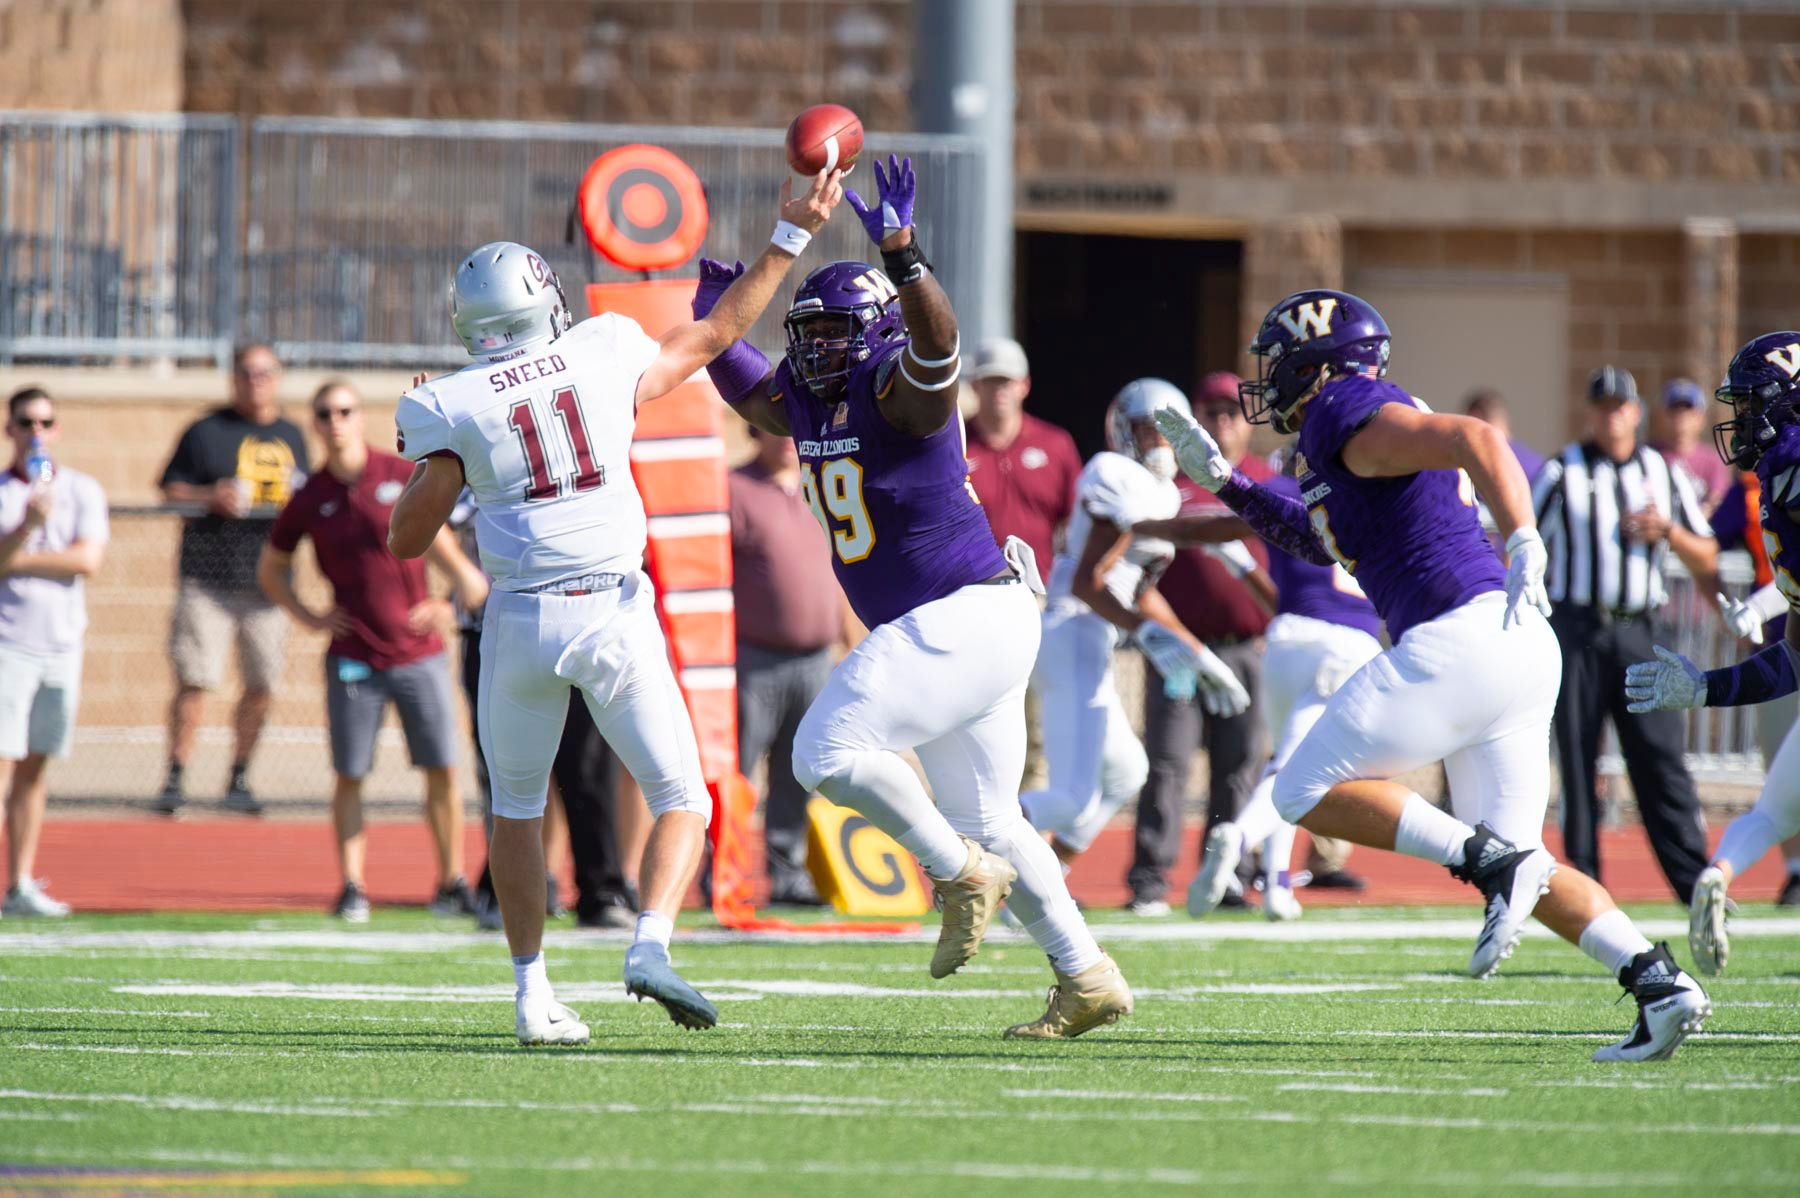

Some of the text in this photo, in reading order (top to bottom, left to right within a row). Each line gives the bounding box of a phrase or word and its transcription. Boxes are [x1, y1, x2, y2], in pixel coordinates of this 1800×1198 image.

[852, 268, 899, 305] W
[503, 331, 514, 343] 11
[1277, 298, 1337, 342] W
[488, 348, 526, 363] MONTANA
[489, 354, 567, 393] SNEED
[506, 384, 606, 502] 11
[840, 816, 906, 896] G
[1478, 846, 1516, 868] adidas
[1637, 975, 1675, 985] adidas
